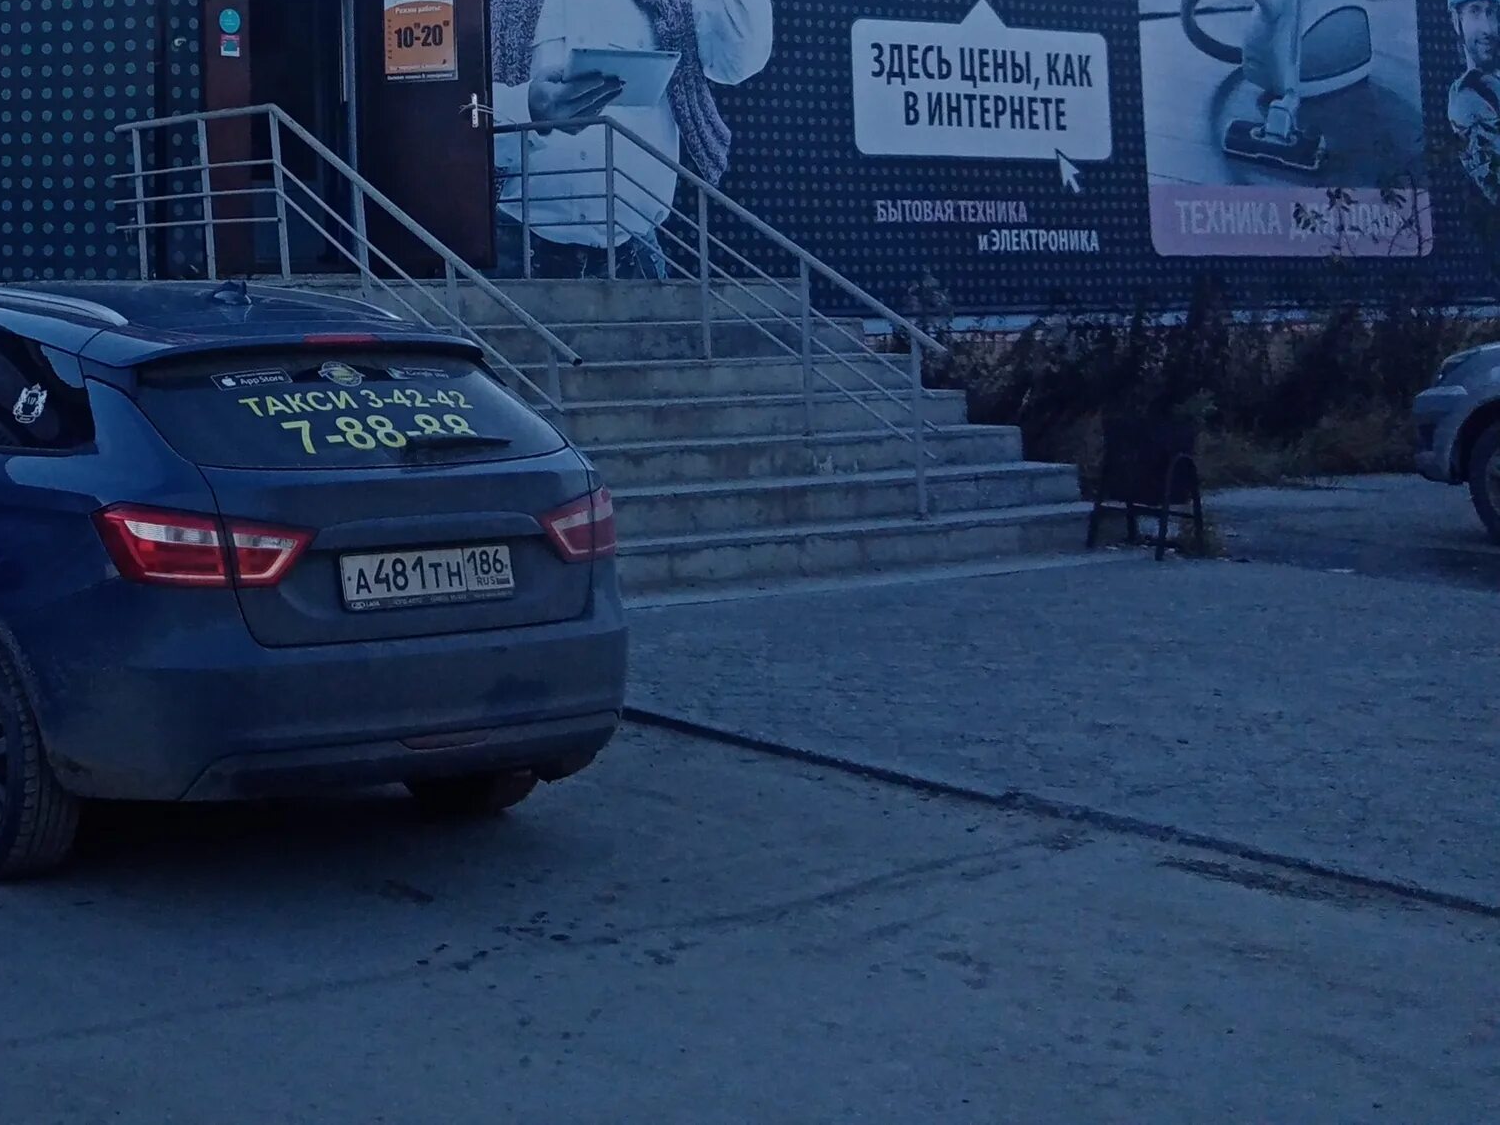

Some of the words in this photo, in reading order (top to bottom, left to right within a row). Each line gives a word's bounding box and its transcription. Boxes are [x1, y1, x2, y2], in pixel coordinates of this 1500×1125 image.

[870, 42, 953, 85] ЗДЕСЬ
[959, 48, 1041, 91] ЦЕНЫ,
[1046, 53, 1093, 88] КАК
[903, 92, 920, 127] В
[927, 92, 1067, 131] ИНТЕРНЕТЕ
[876, 198, 955, 223] БЫТОВАЯ
[959, 200, 1028, 223] ТЕХНИКА
[1175, 201, 1283, 235] ТЕХНИКА
[990, 228, 1100, 253] ЭЛЕКТРОНИКА
[239, 388, 358, 418] ТАКСИ
[361, 388, 473, 410] 3-42-42
[355, 556, 463, 595] А481ТН
[467, 549, 505, 576] 186
[476, 576, 496, 588] RUS
